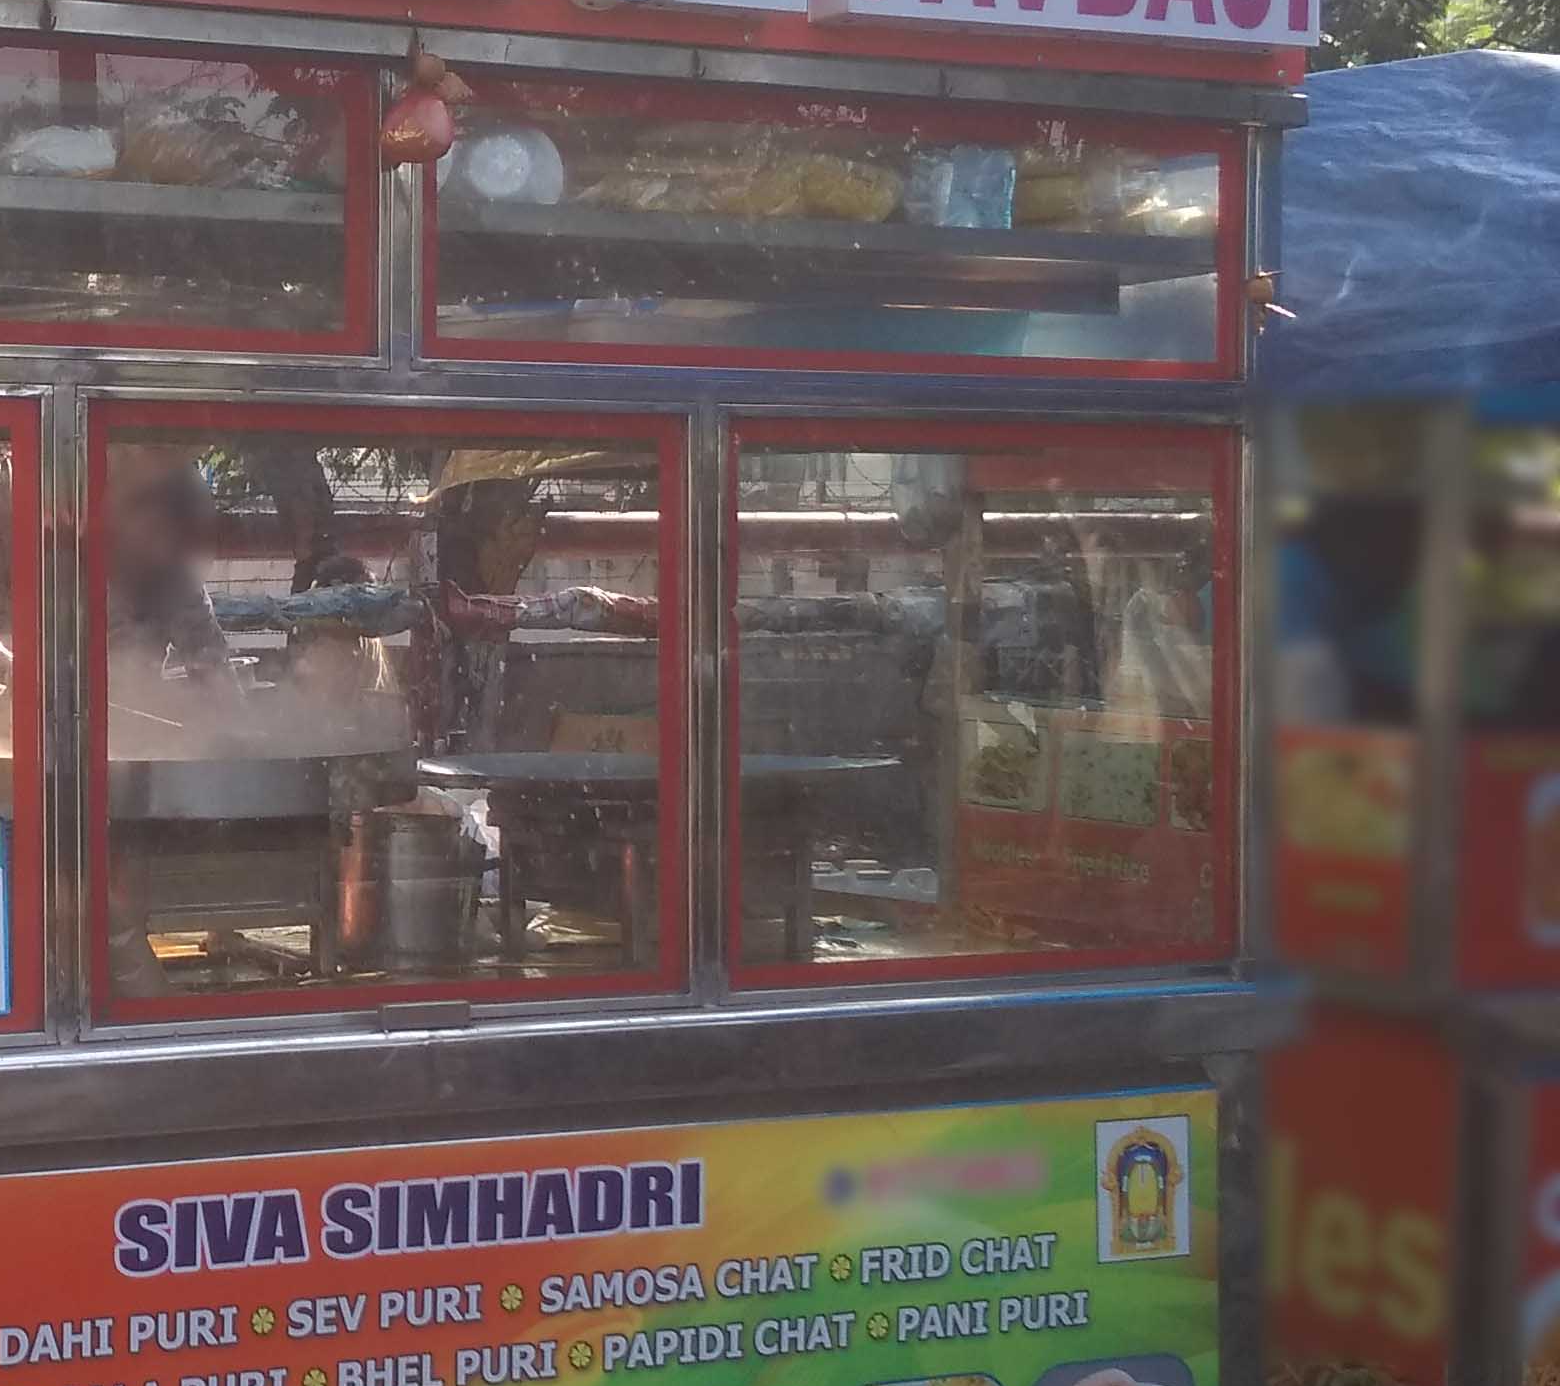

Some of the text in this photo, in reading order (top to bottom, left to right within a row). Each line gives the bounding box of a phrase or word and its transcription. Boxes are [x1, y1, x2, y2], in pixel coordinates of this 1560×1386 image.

[115, 1157, 705, 1277] SIVA SIMHADRI
[127, 1305, 240, 1355] PURI
[286, 1294, 368, 1340] SEV
[377, 1282, 484, 1331] PURI
[538, 1264, 705, 1315] SAMOSA
[714, 1253, 819, 1297] CHAT
[858, 1241, 952, 1285] FRID
[959, 1231, 1058, 1277] CHAT
[600, 1322, 745, 1374] PAPIDI
[754, 1312, 857, 1358] CHAT
[895, 1301, 988, 1343] PANI
[997, 1289, 1091, 1334] PURI
